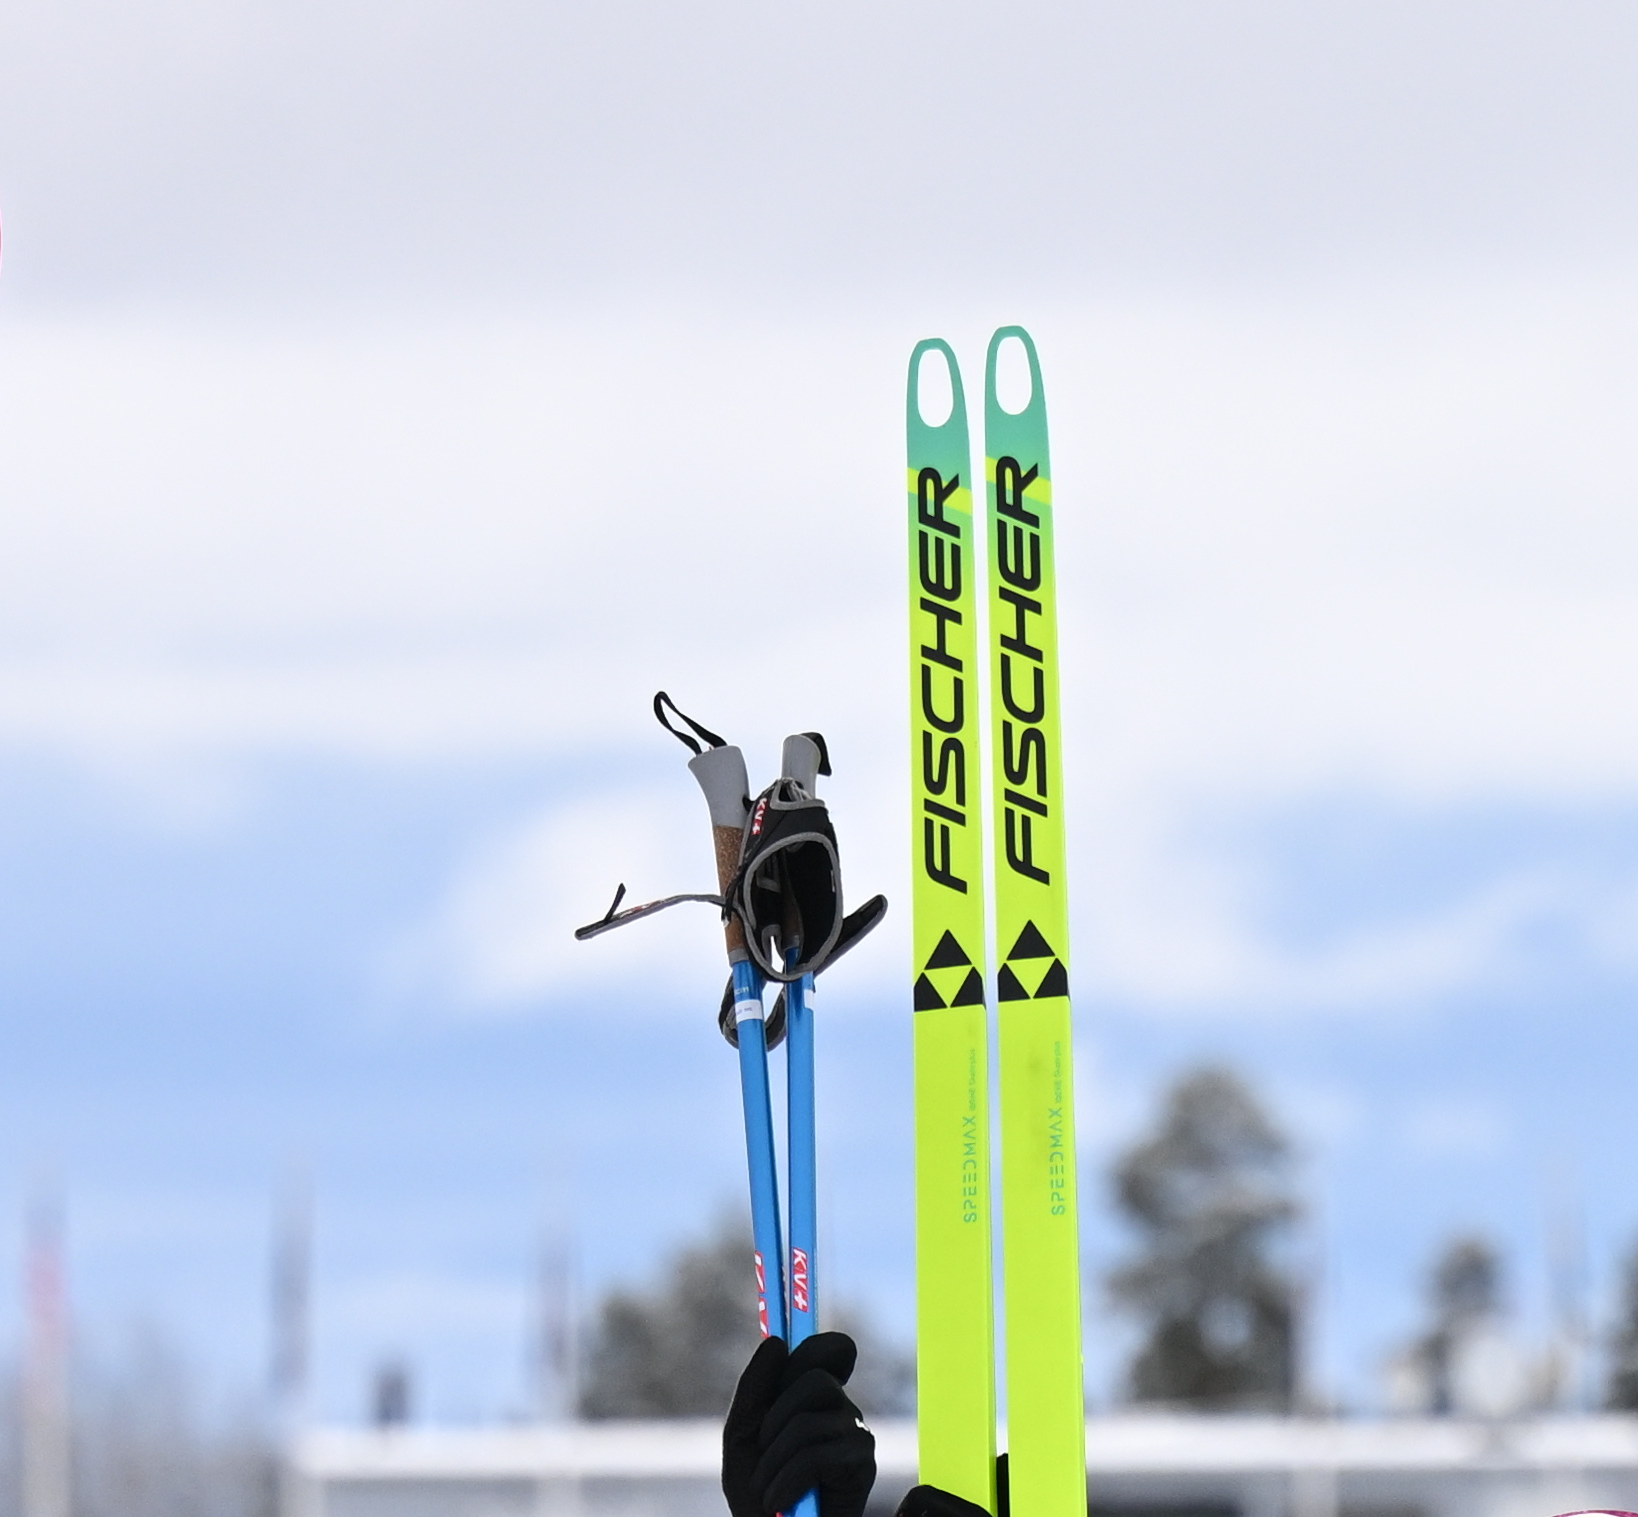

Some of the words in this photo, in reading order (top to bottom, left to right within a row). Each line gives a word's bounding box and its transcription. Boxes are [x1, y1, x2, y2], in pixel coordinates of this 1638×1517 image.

[917, 466, 968, 896] FISCHER
[995, 456, 1050, 887] FISCHER
[793, 1248, 808, 1312] KV+
